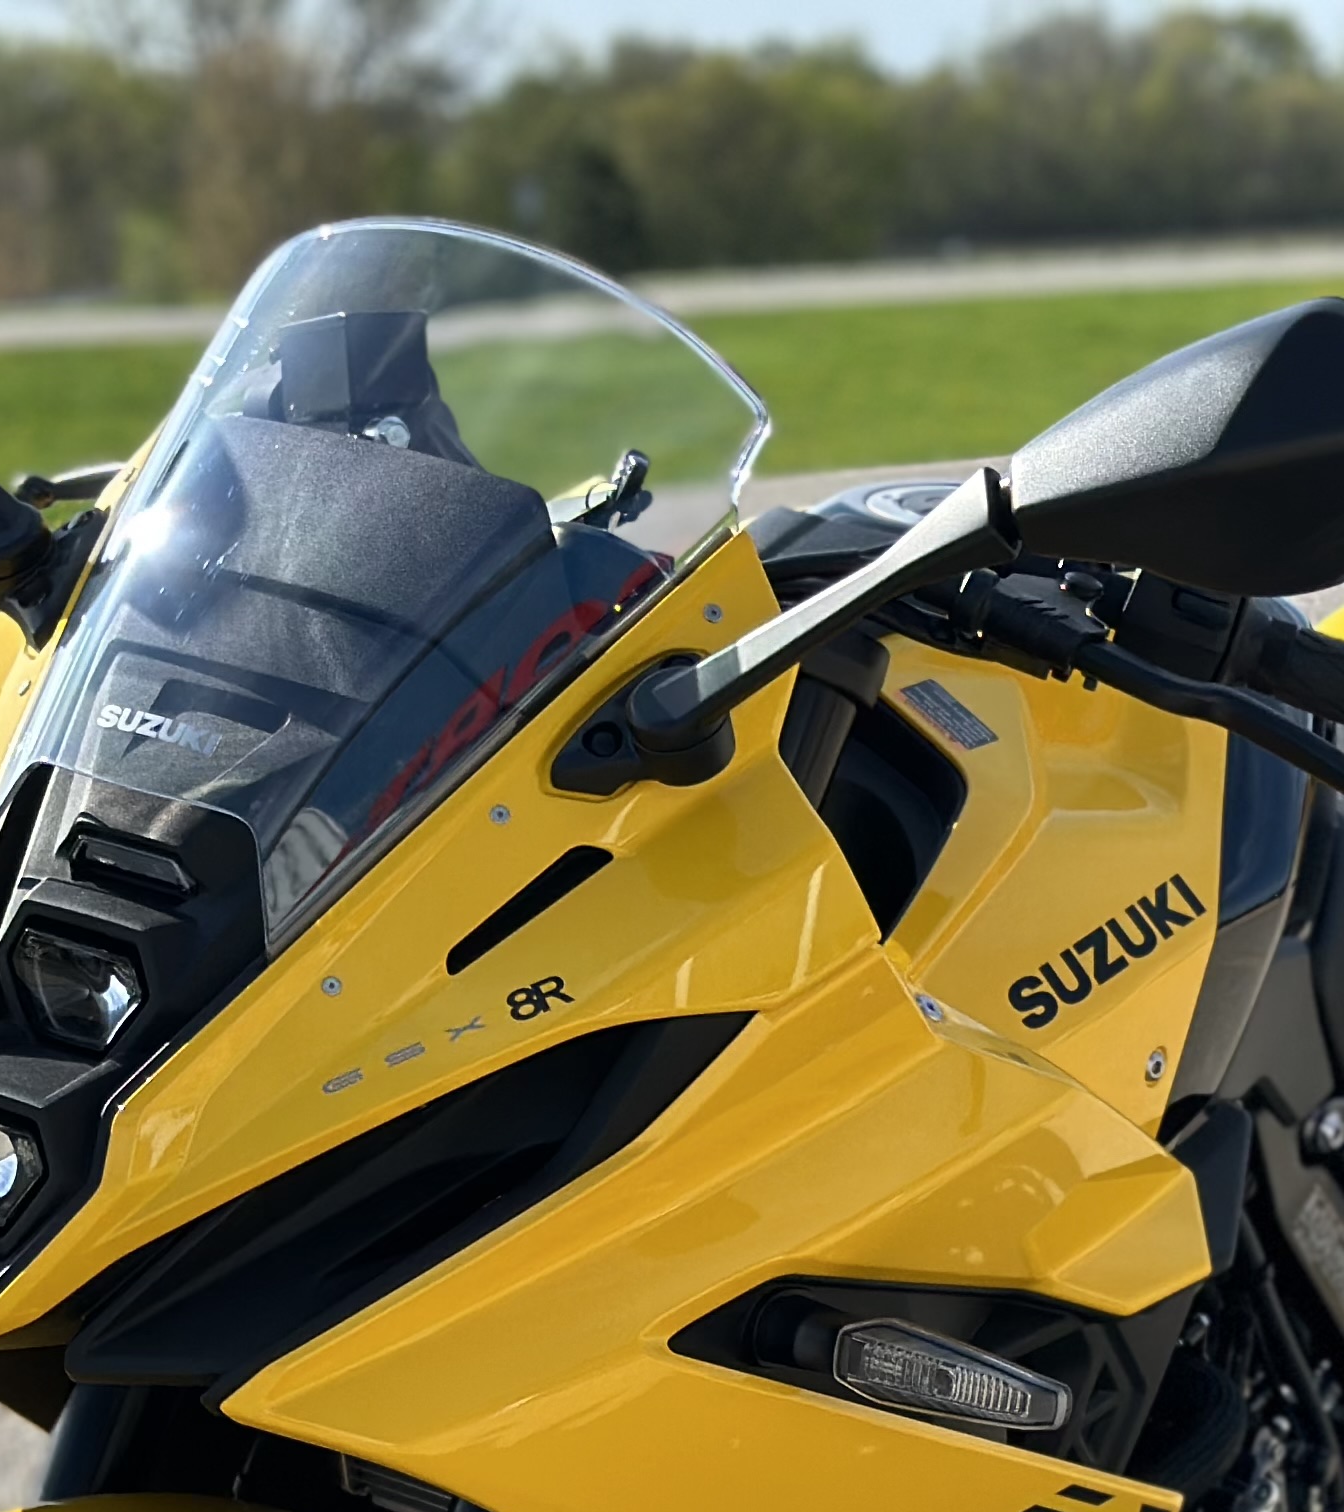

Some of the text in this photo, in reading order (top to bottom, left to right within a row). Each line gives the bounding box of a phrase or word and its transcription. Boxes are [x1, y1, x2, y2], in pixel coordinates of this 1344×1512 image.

[96, 704, 223, 758] SUZUKI
[1007, 873, 1207, 1030] SUZUKI
[506, 975, 576, 1021] 8R
